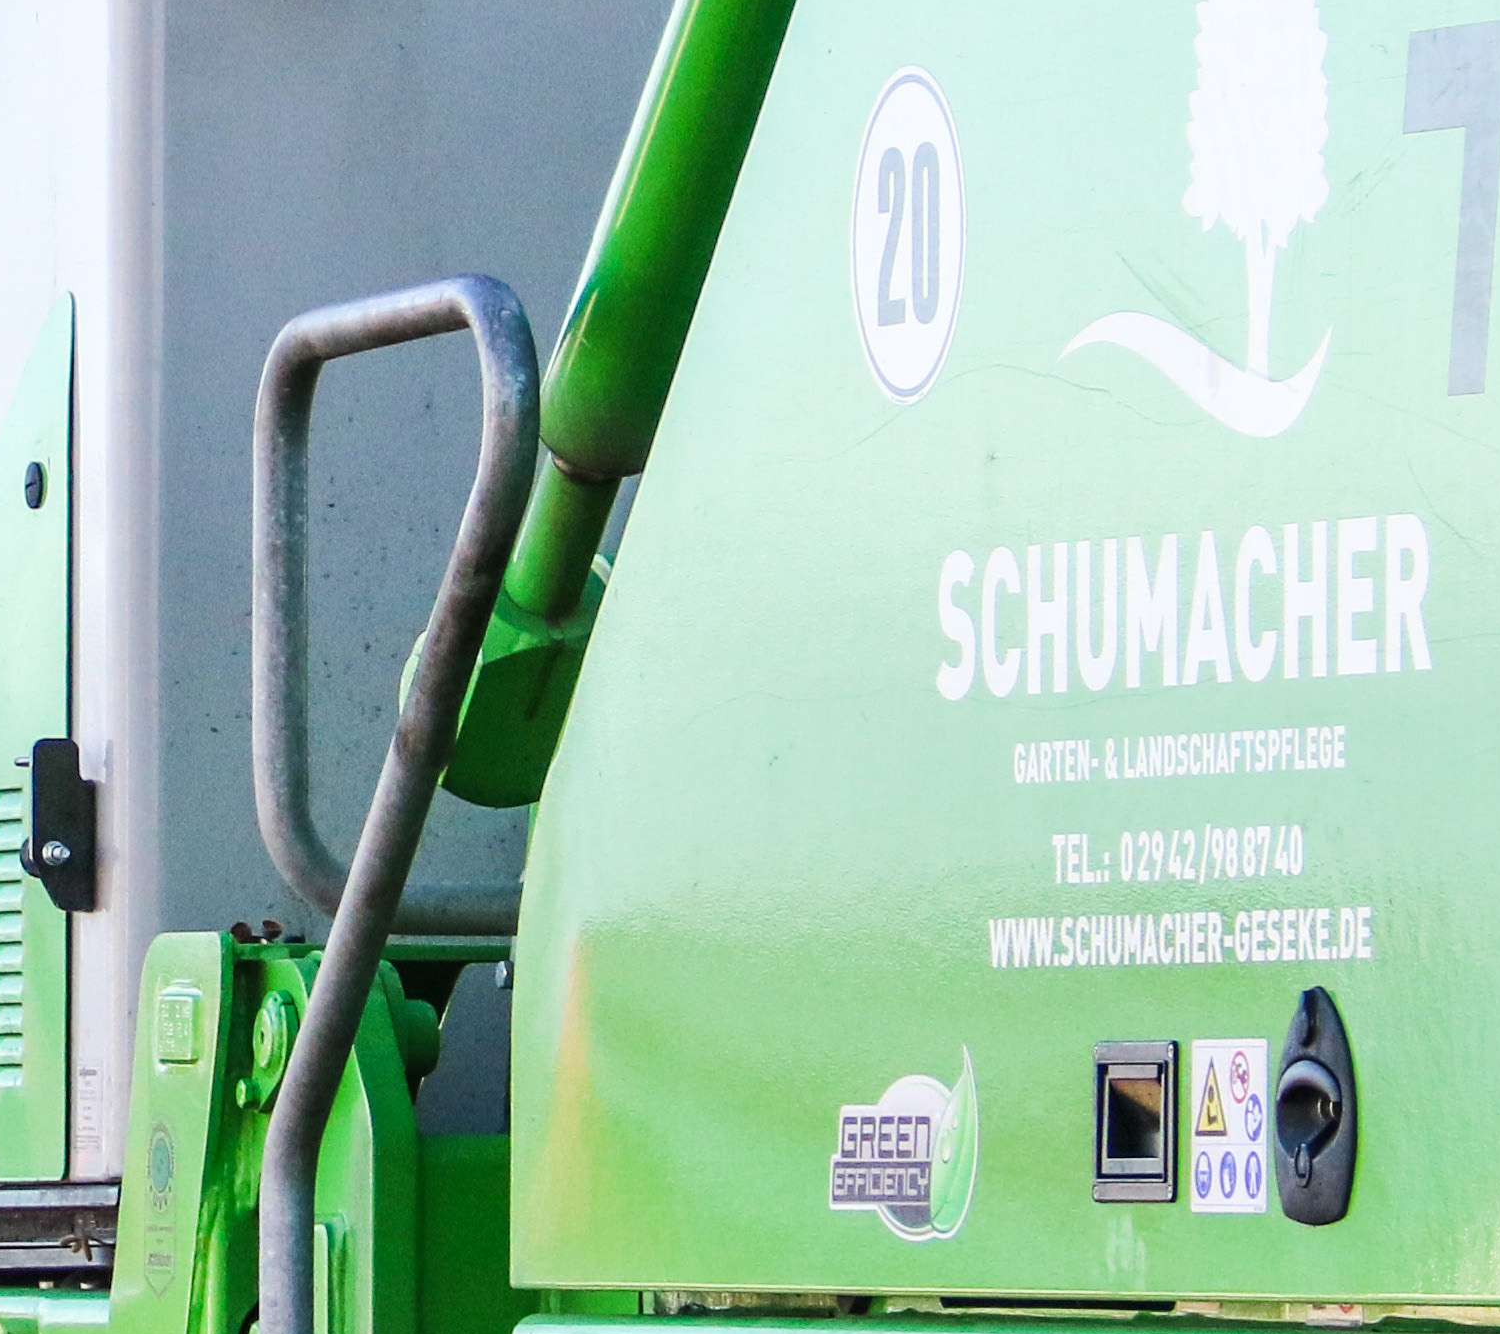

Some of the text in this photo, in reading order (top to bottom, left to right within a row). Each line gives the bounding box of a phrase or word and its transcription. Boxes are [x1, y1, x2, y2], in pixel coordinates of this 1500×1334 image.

[876, 138, 941, 329] 20
[936, 514, 1432, 700] SCHUMACHER
[1014, 725, 1346, 784] GARTEN- & LANDSCHAFTSPFLEGE
[1052, 833, 1110, 884] TEL.:
[988, 906, 1372, 968] WWW.SCHUMACHER-GESEKE.DE
[841, 1116, 930, 1159] GREEN
[833, 1167, 929, 1197] EFFICIENCY
